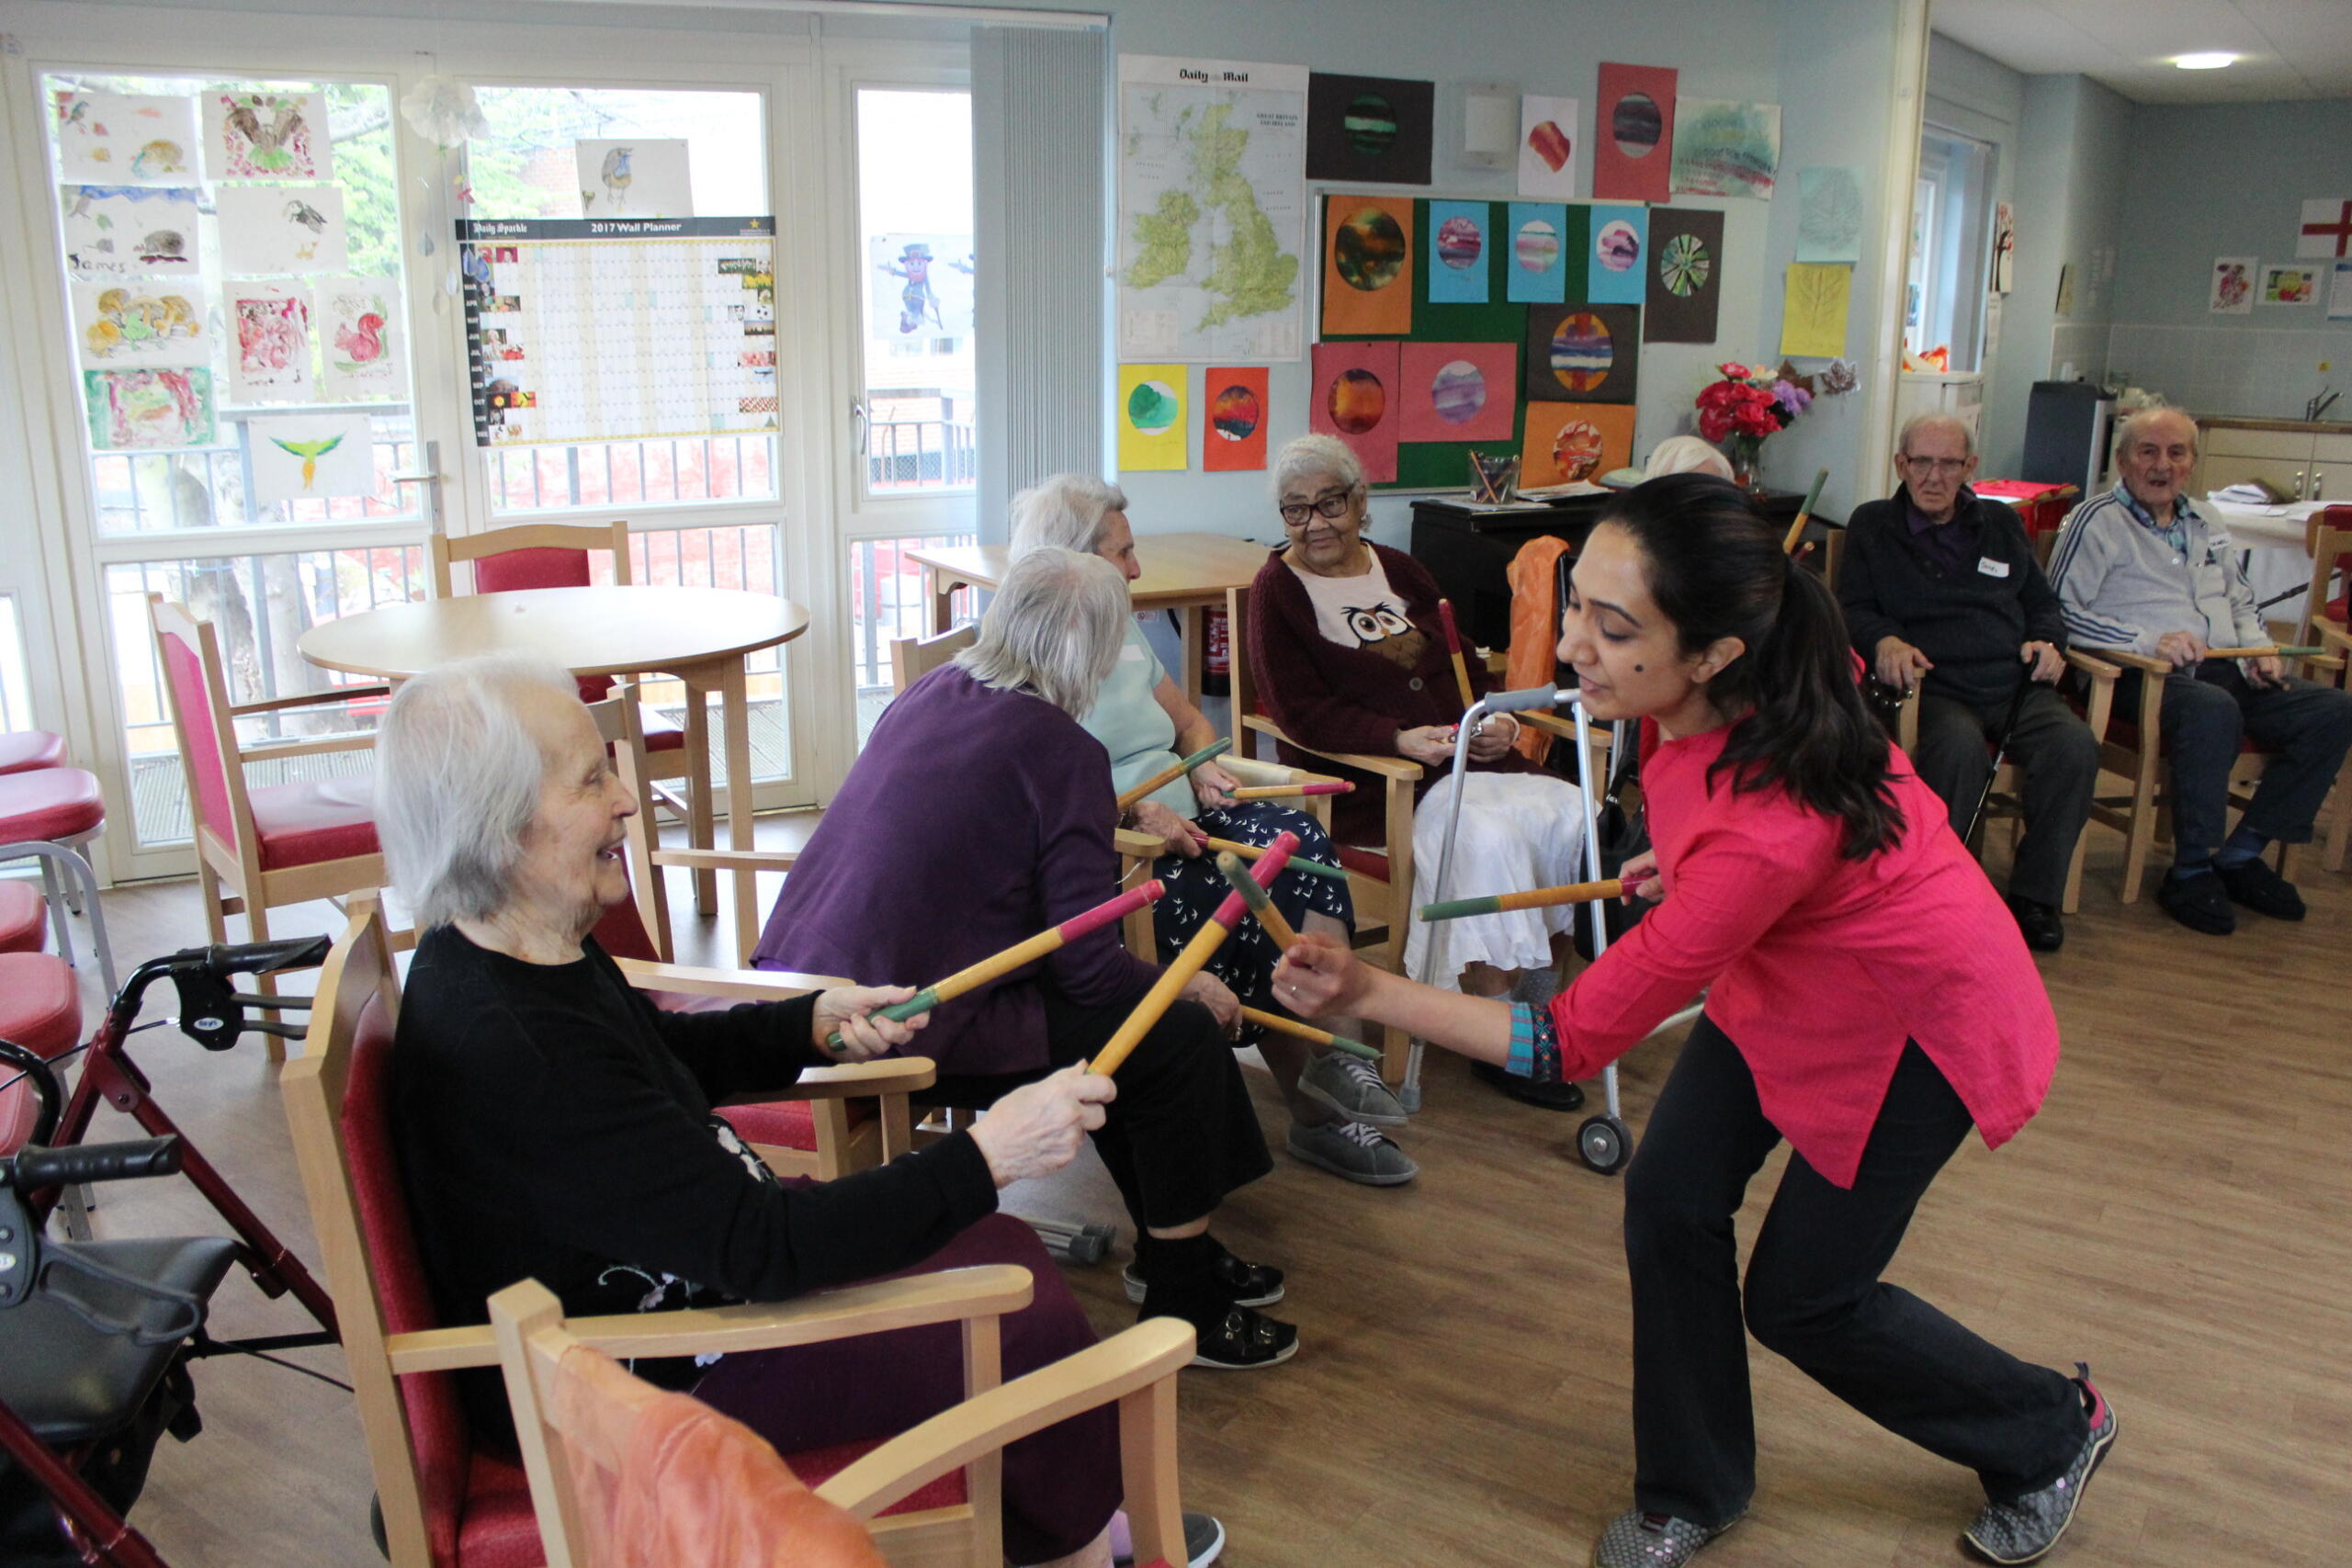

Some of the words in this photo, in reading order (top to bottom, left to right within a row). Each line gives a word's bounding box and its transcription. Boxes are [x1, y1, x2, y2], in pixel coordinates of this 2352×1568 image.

[1180, 68, 1209, 84] Daily
[1223, 72, 1249, 83] Mail
[591, 222, 615, 233] 2017
[616, 222, 640, 233] Wall
[643, 221, 682, 232] Planner
[68, 254, 126, 274] James
